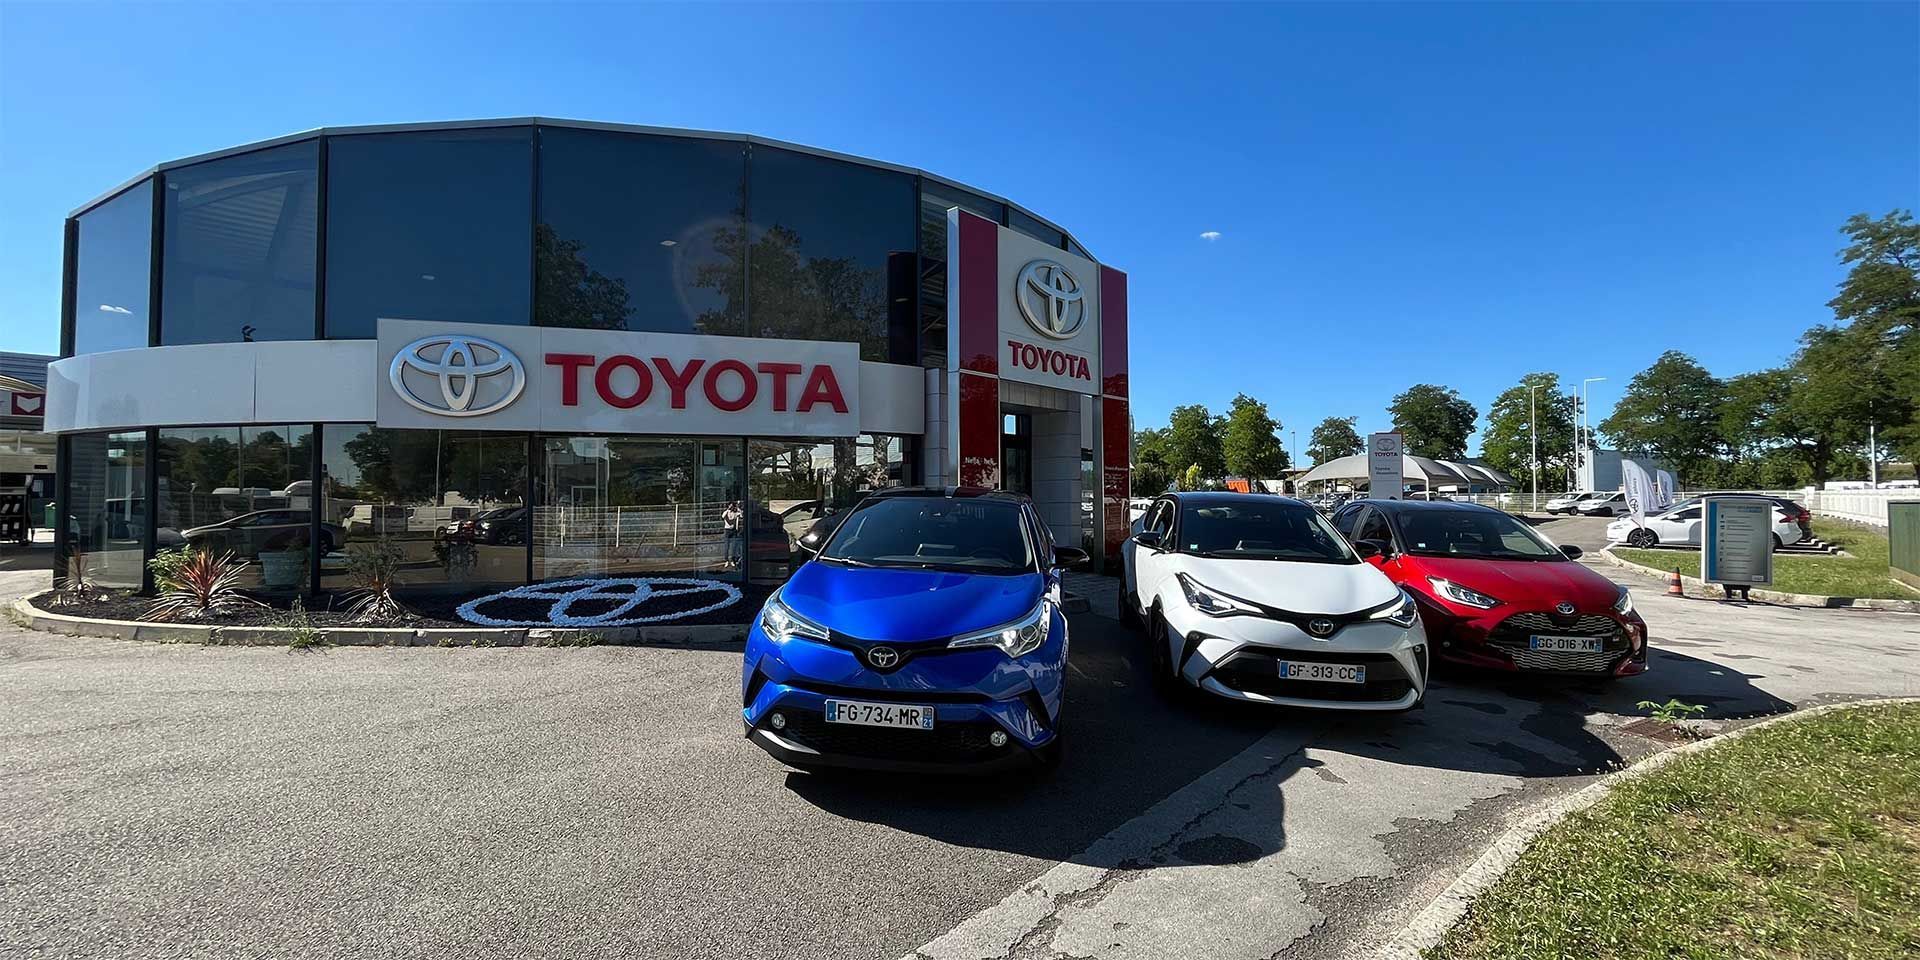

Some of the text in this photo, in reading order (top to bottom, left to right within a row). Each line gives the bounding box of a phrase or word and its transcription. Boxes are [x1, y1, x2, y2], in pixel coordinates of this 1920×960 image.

[1007, 340, 1091, 381] TOYOTA
[545, 353, 849, 413] TOYOTA
[1288, 664, 1356, 680] GF-313-CC
[837, 703, 920, 726] FG-734-MR
